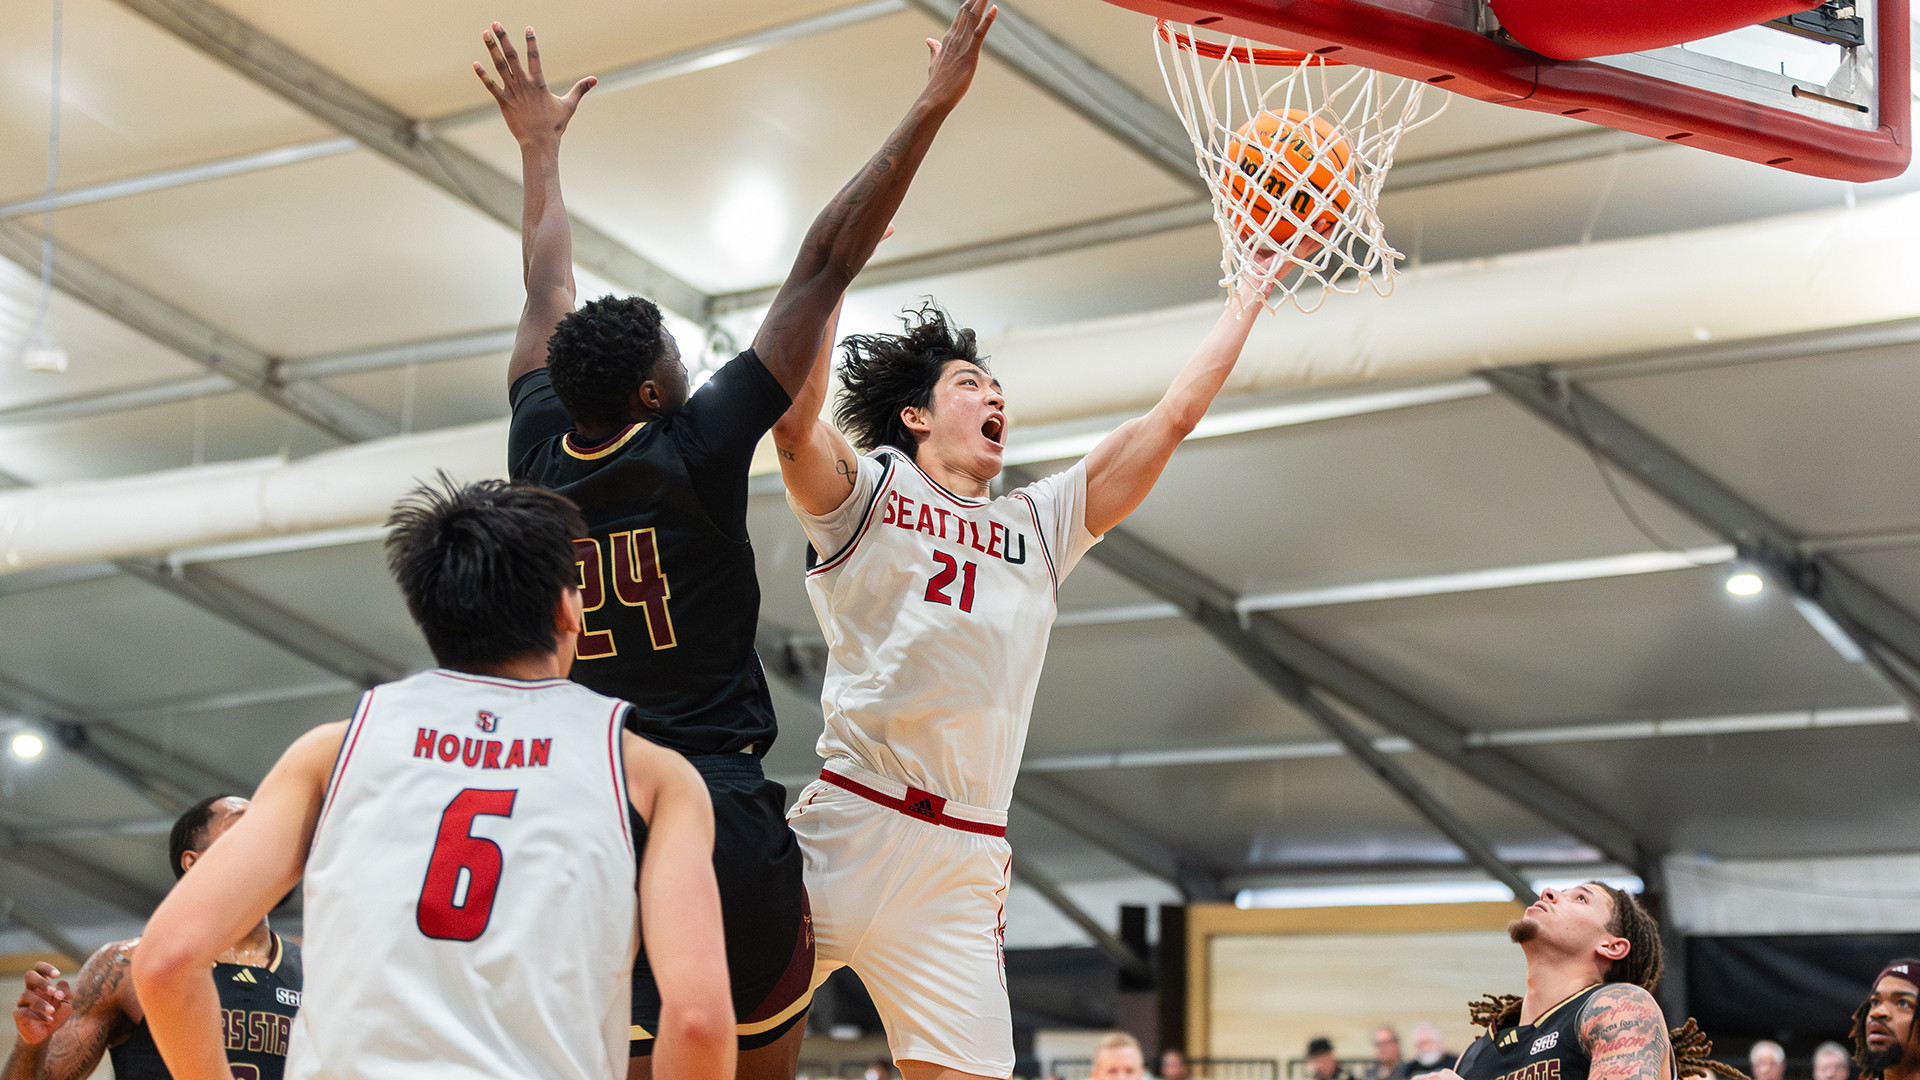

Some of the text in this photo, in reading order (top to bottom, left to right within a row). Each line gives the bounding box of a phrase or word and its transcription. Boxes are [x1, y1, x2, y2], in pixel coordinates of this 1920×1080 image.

[571, 527, 678, 661] 24
[923, 549, 978, 614] 21
[413, 727, 553, 770] HOURAN
[416, 787, 519, 942] 6
[275, 987, 303, 1008] SB
[248, 1011, 293, 1057] STA
